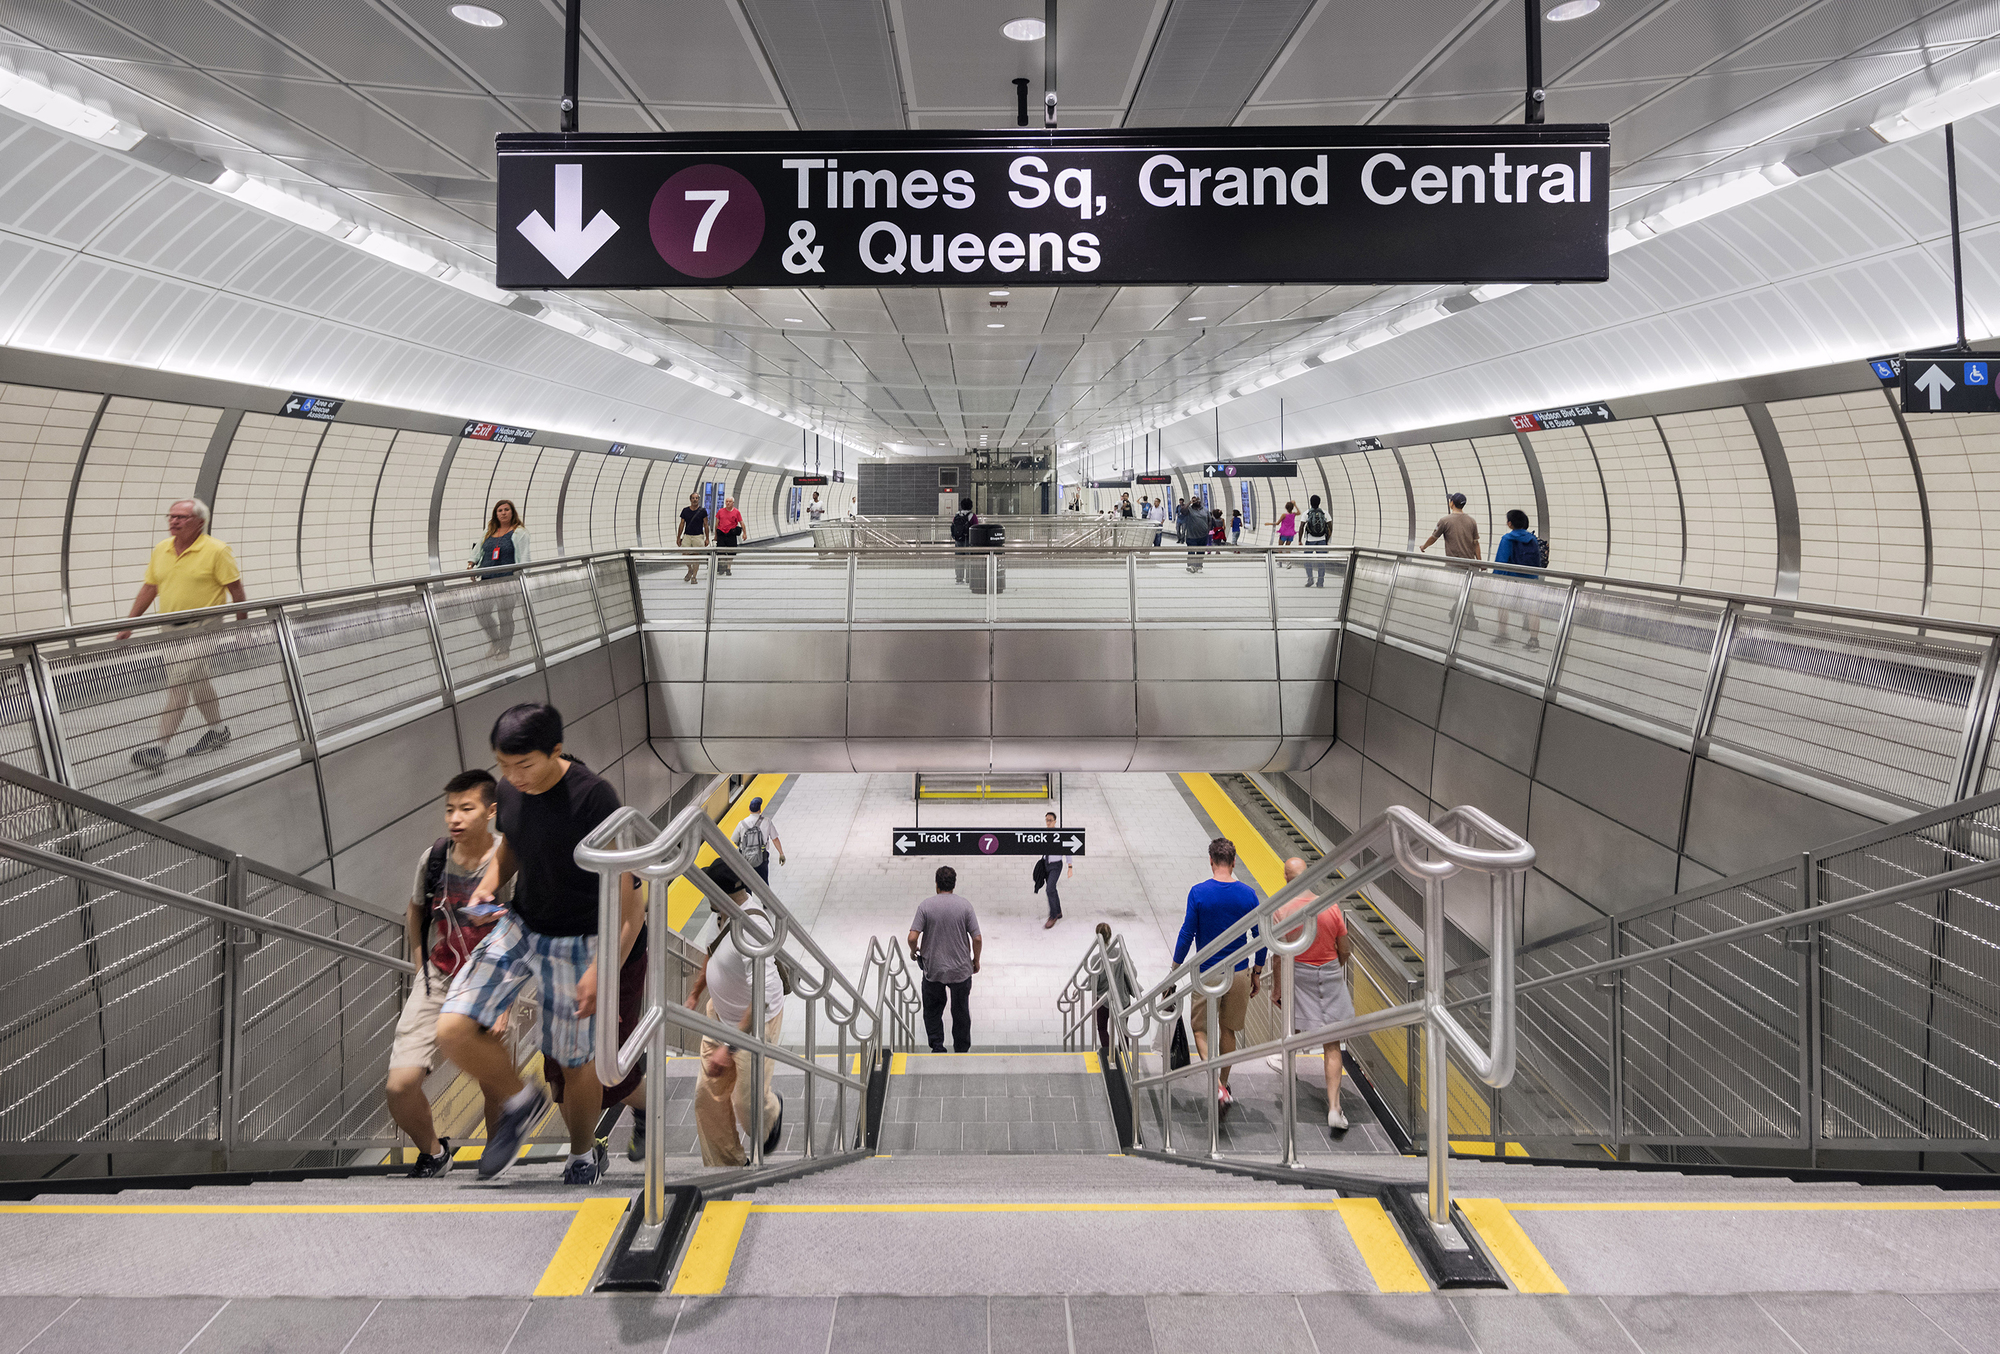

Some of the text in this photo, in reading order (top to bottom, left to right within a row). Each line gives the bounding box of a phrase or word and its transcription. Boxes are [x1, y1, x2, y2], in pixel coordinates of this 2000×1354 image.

[782, 150, 1593, 220] Times Sq, Grand Central
[684, 189, 730, 253] 7
[781, 219, 1102, 275] & Queens
[307, 412, 334, 420] Assistance
[1538, 406, 1593, 421] Hudson Blvd East
[1511, 416, 1533, 429] Exit
[472, 423, 493, 437] Exit
[1227, 467, 1234, 475] 7
[917, 832, 962, 843] Track 1
[984, 837, 994, 851] 7
[1015, 832, 1061, 843] Track 2
